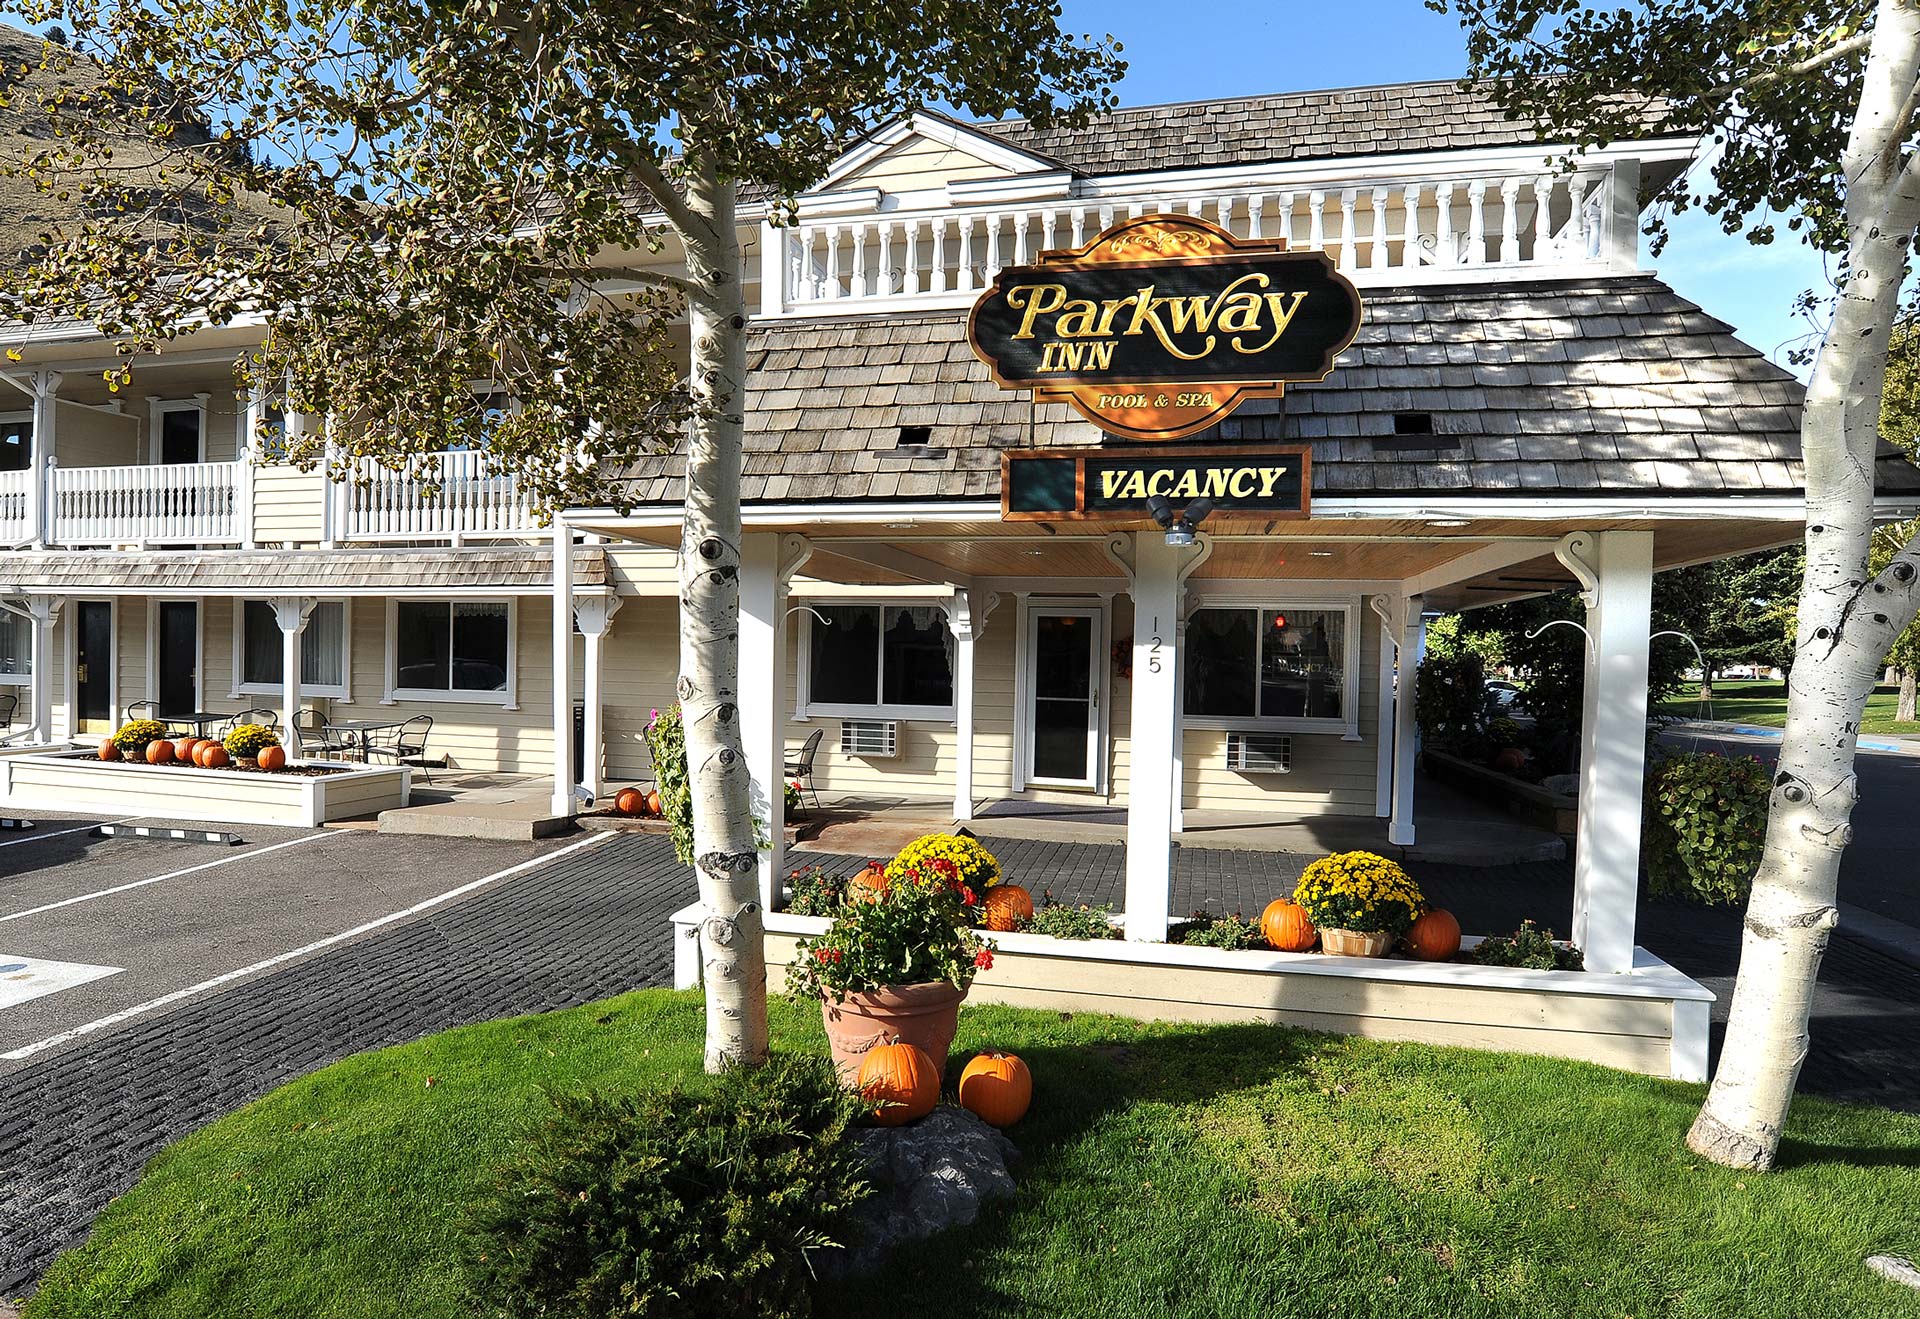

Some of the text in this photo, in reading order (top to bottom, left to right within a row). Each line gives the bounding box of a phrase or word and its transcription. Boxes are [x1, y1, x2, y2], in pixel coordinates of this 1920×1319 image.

[1006, 272, 1308, 360] Parkway
[1037, 340, 1118, 373] INN
[1097, 391, 1213, 409] POOL & SPA
[1100, 466, 1286, 499] VACANCY
[1149, 616, 1162, 673] 125
